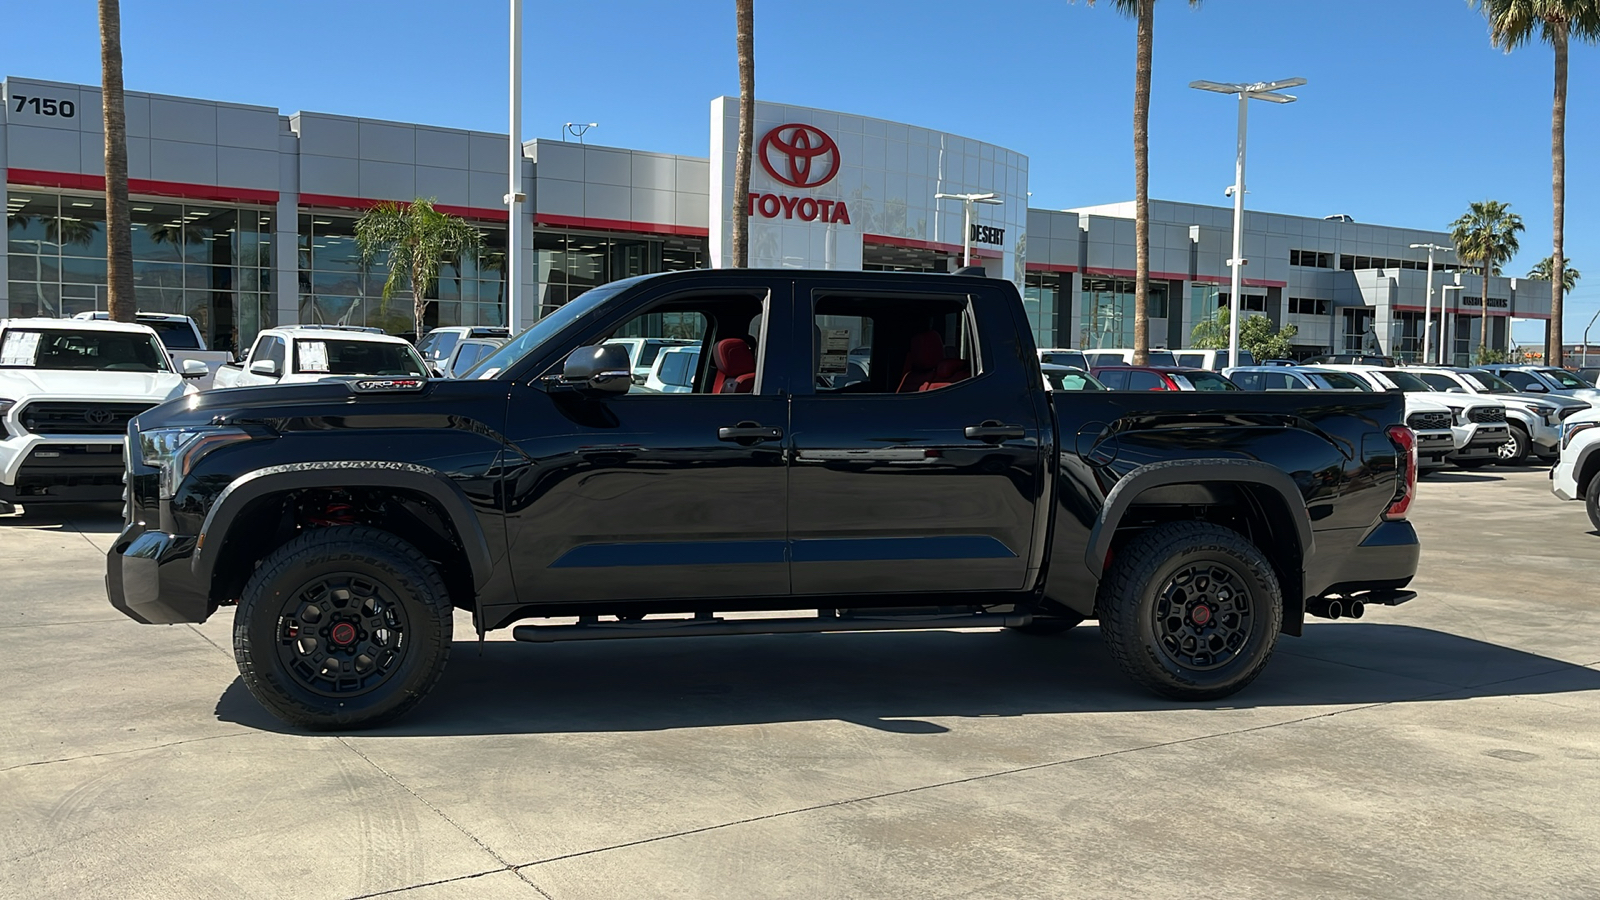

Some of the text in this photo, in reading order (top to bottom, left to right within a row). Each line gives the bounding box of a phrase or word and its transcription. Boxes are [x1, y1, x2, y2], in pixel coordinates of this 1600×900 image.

[12, 95, 75, 118] 7150
[748, 193, 851, 225] TOYOTA
[970, 223, 1005, 246] DESERT
[1181, 545, 1252, 567] WILDPEAK
